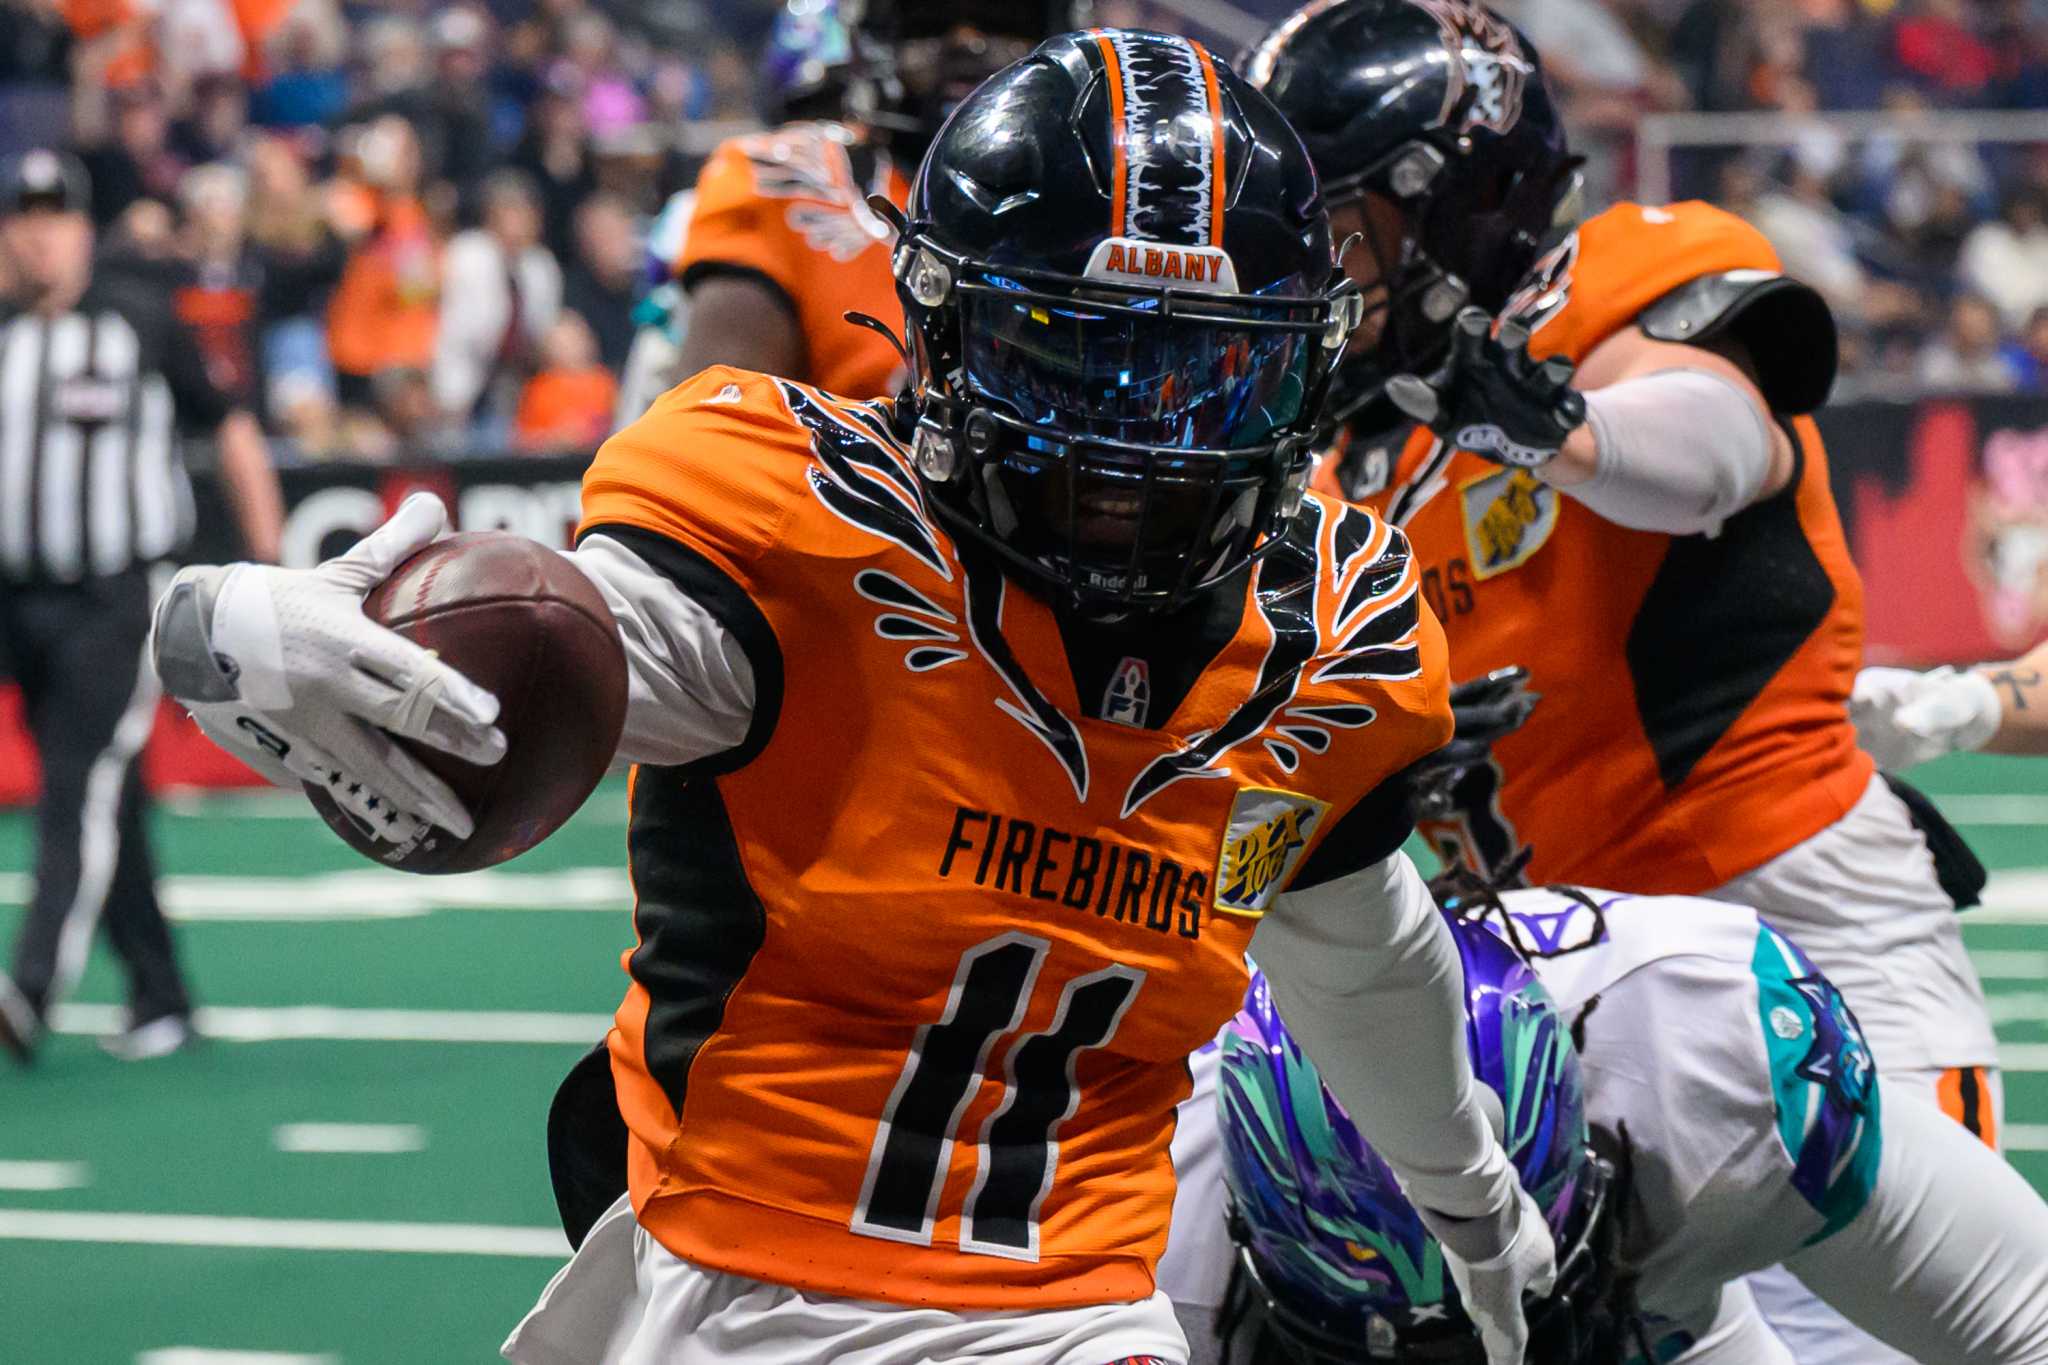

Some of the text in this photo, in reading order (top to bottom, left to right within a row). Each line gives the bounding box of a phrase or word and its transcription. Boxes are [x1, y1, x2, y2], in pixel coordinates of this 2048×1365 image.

[1106, 244, 1224, 283] ALBANY
[939, 806, 1208, 940] FIREBIRDS
[849, 930, 1147, 1264] 11
